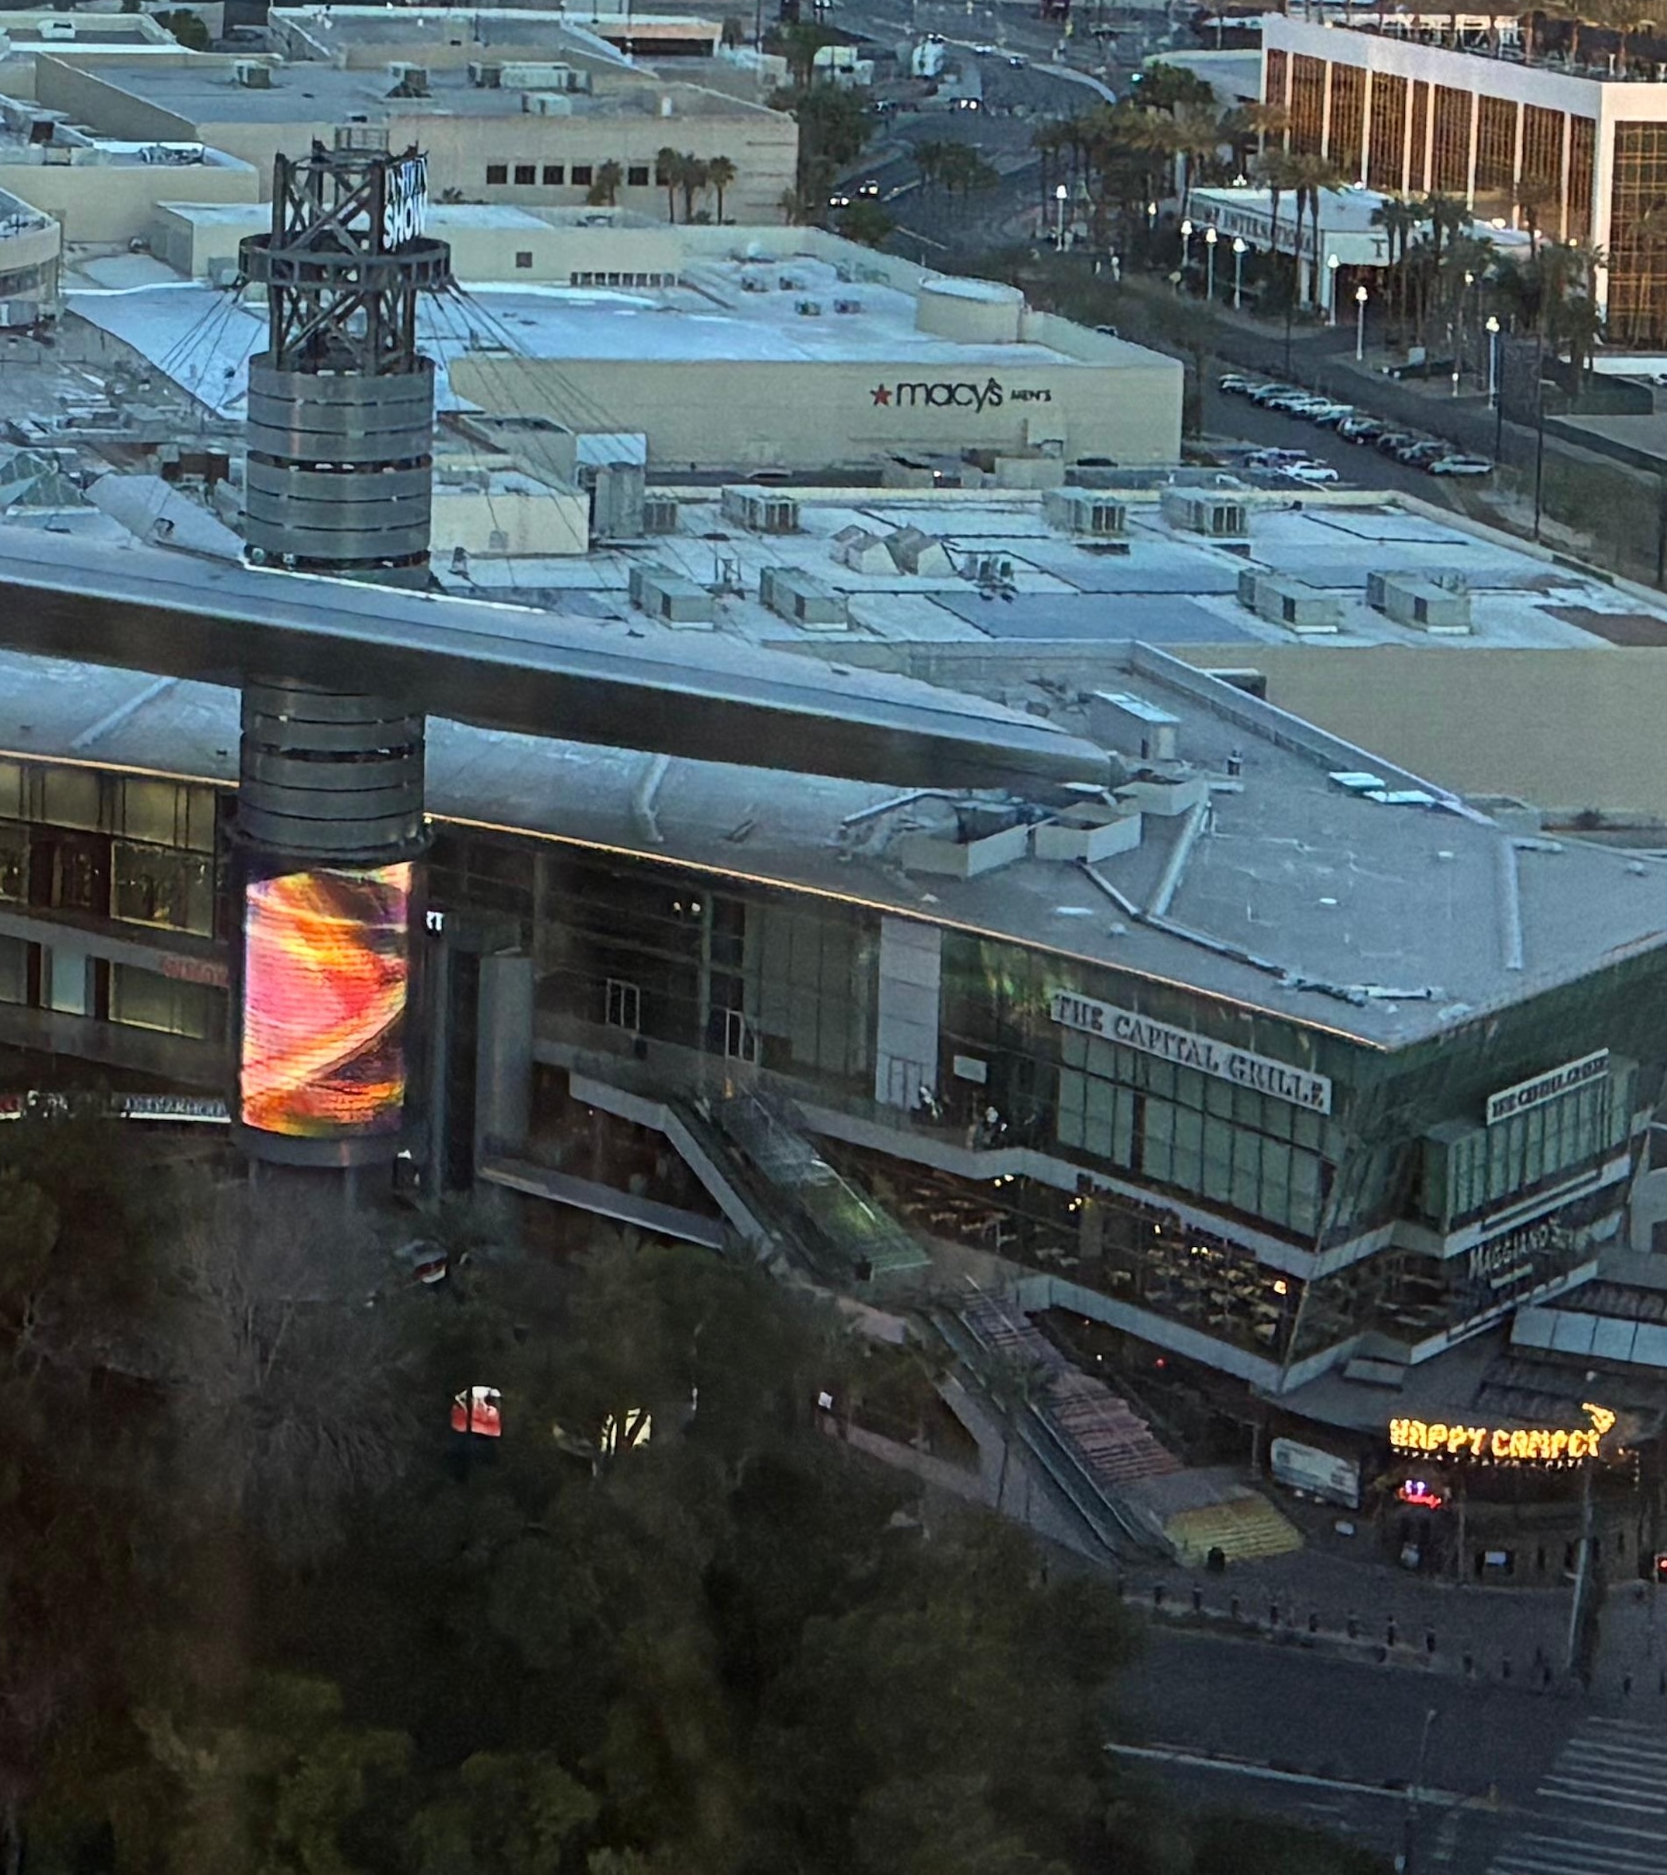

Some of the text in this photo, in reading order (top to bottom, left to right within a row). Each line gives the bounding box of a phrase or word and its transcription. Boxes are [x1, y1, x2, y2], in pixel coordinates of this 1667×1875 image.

[896, 377, 1004, 413] macy's
[1057, 993, 1325, 1109] THE CAPITAL GRILLE
[1389, 1418, 1486, 1456] HAPPY
